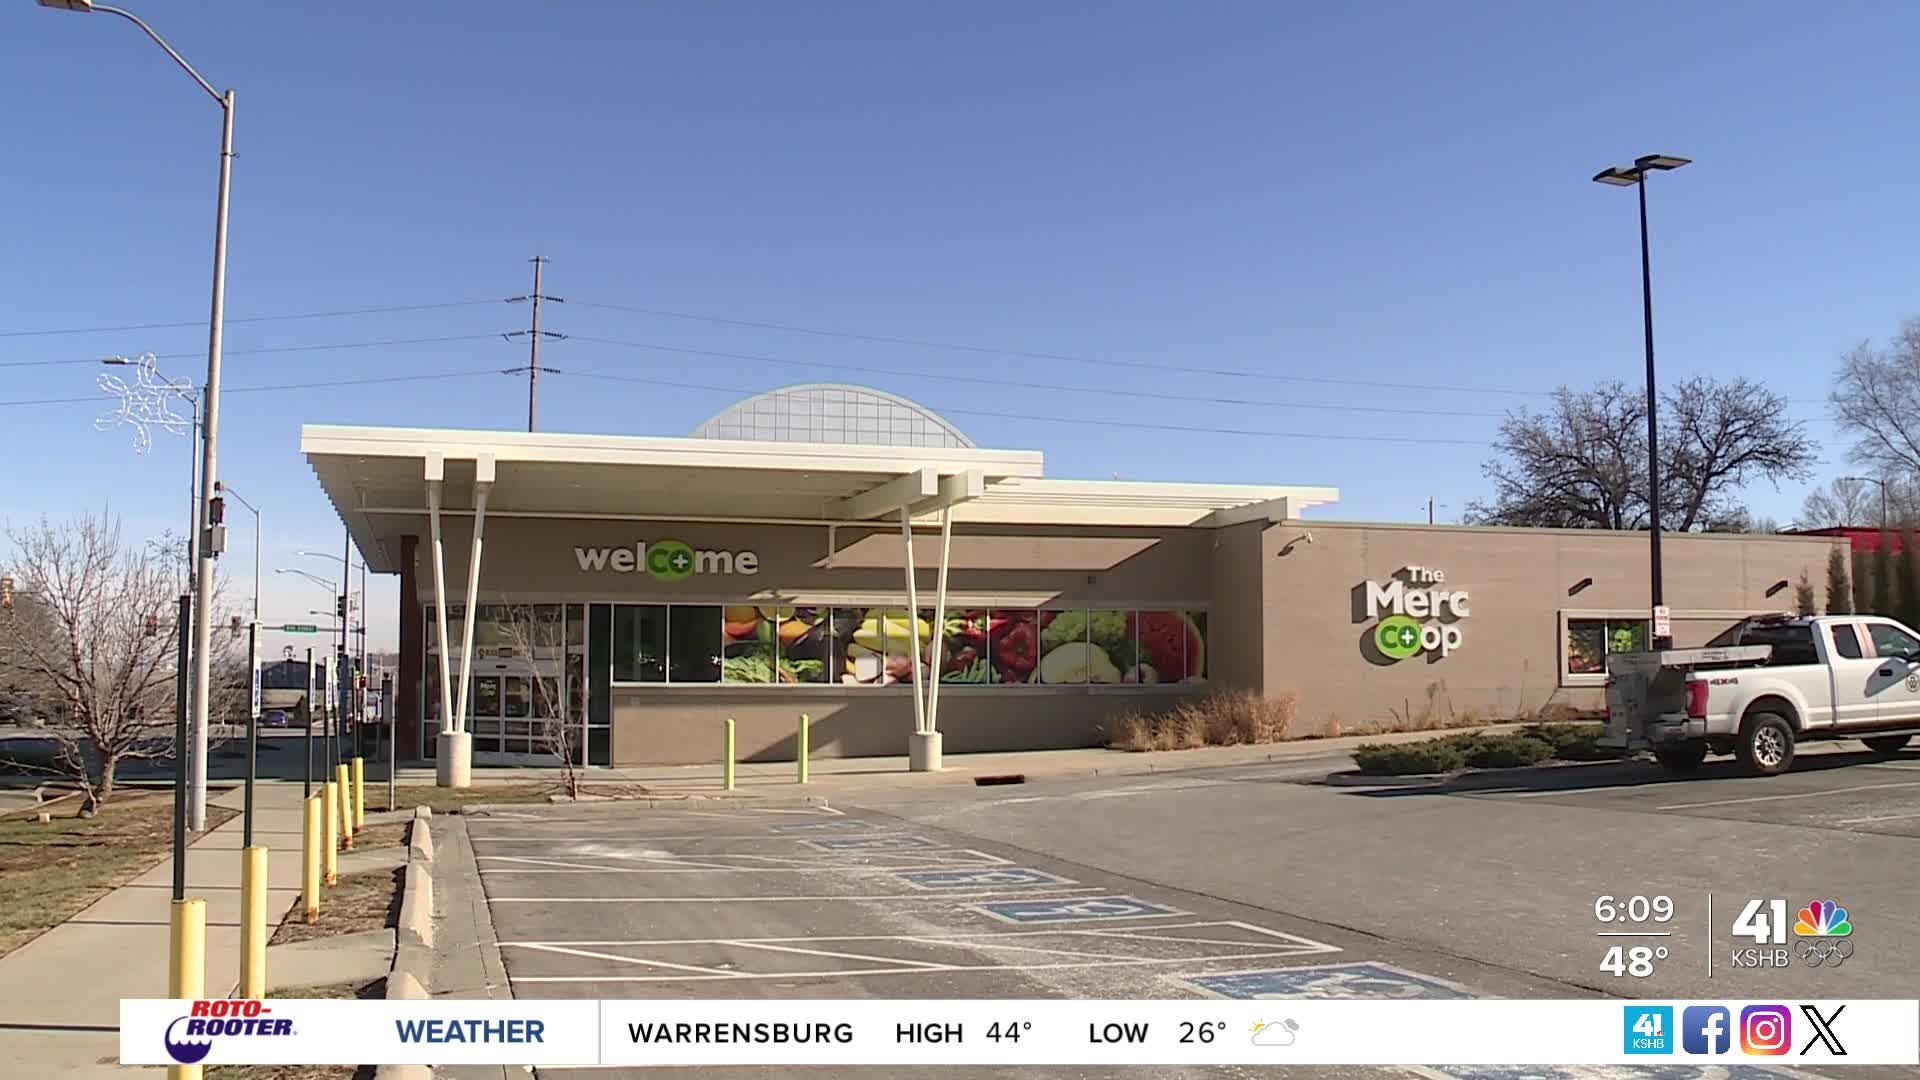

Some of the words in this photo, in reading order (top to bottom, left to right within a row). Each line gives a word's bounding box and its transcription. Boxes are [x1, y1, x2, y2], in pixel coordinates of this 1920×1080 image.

[575, 541, 759, 576] welcome
[1407, 565, 1444, 582] The
[1366, 580, 1470, 617] Merc
